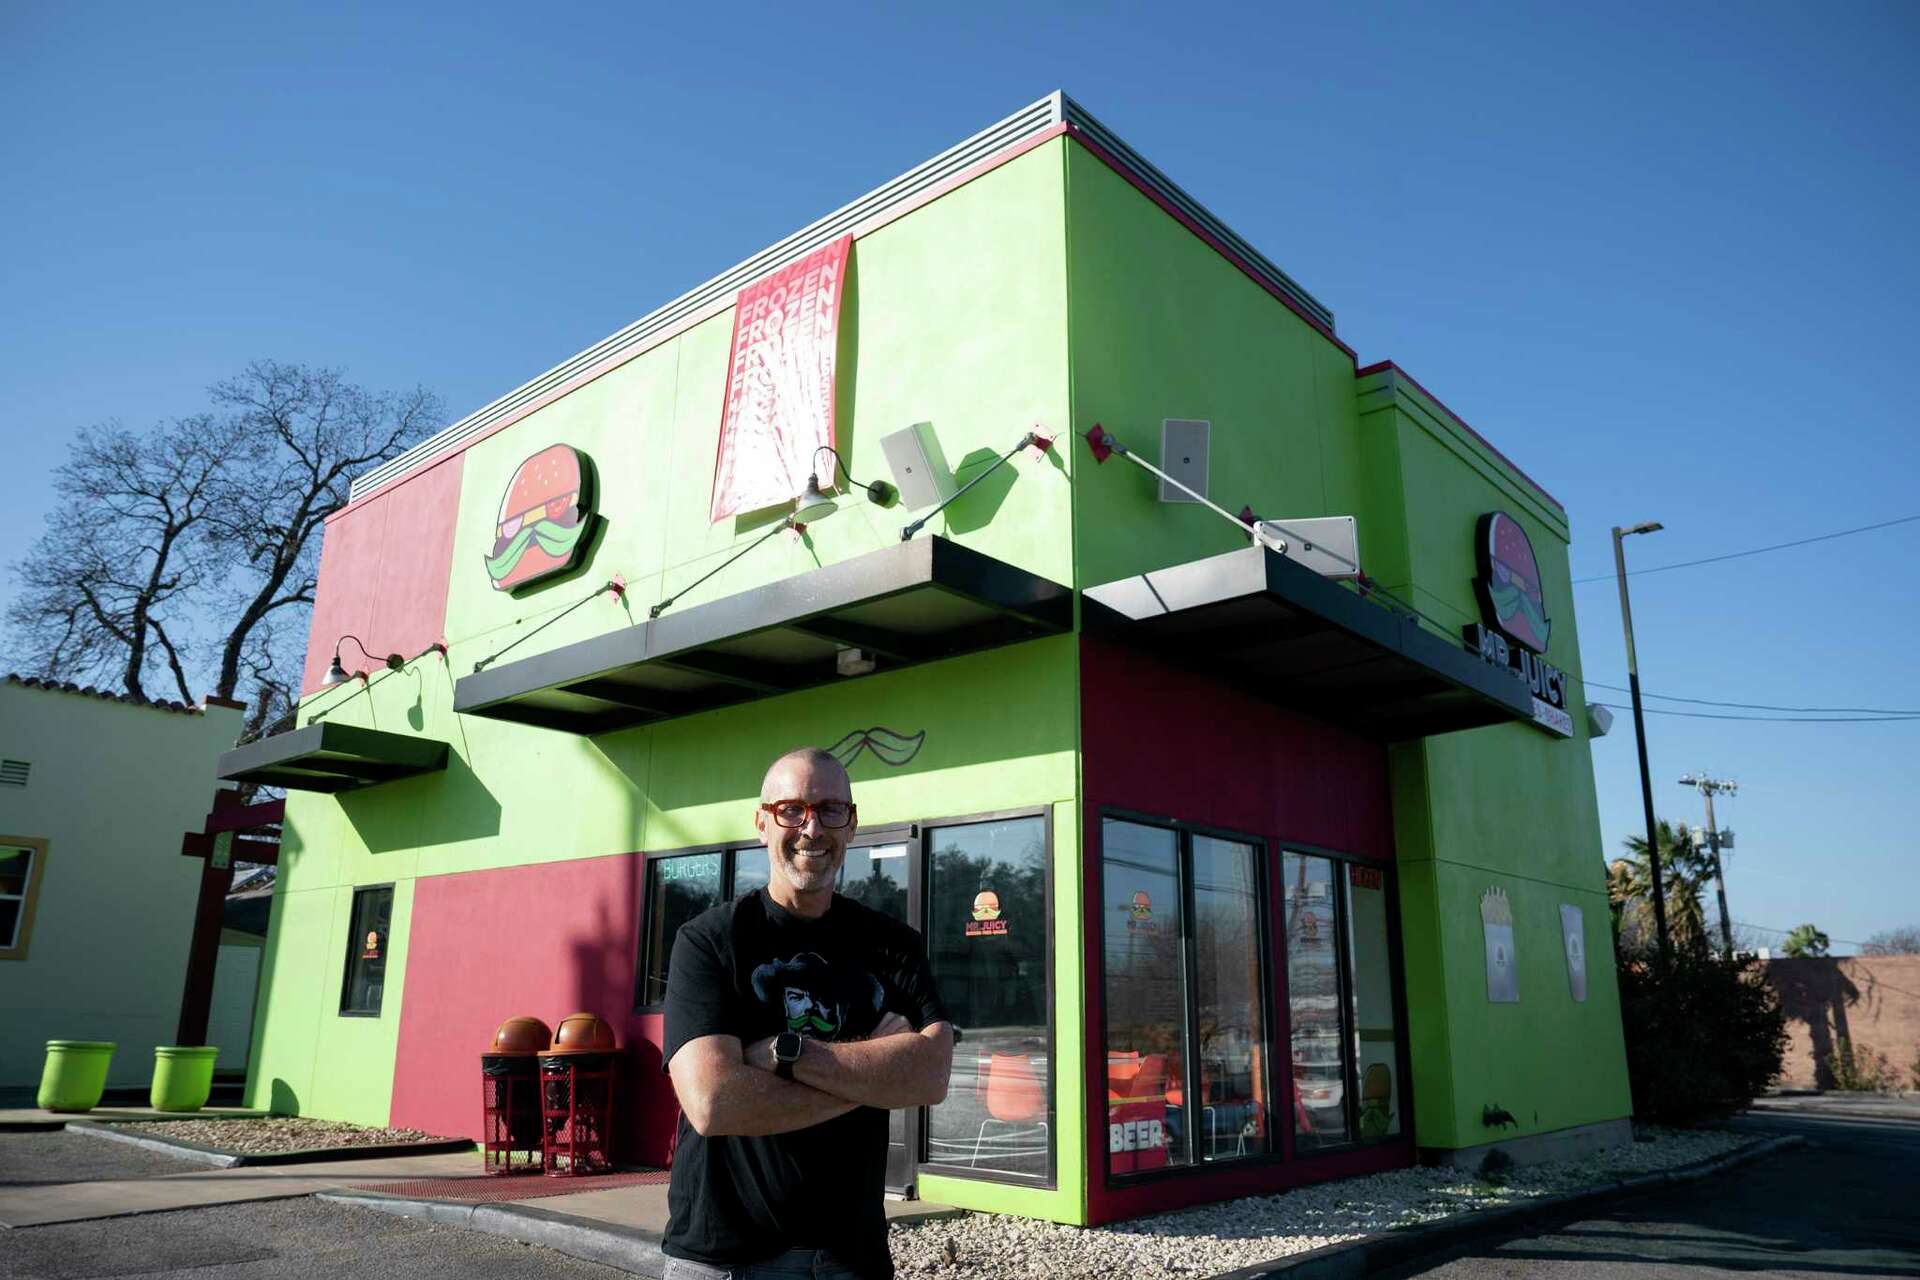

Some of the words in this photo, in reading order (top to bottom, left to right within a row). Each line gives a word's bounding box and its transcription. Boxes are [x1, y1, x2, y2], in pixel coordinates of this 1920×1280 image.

[735, 281, 837, 353] FROZEN
[739, 258, 840, 331] FROZEN
[1518, 648, 1568, 709] JUICY
[664, 854, 718, 880] BURGERS
[980, 919, 1007, 930] JUICY
[1109, 1119, 1163, 1153] BEER
